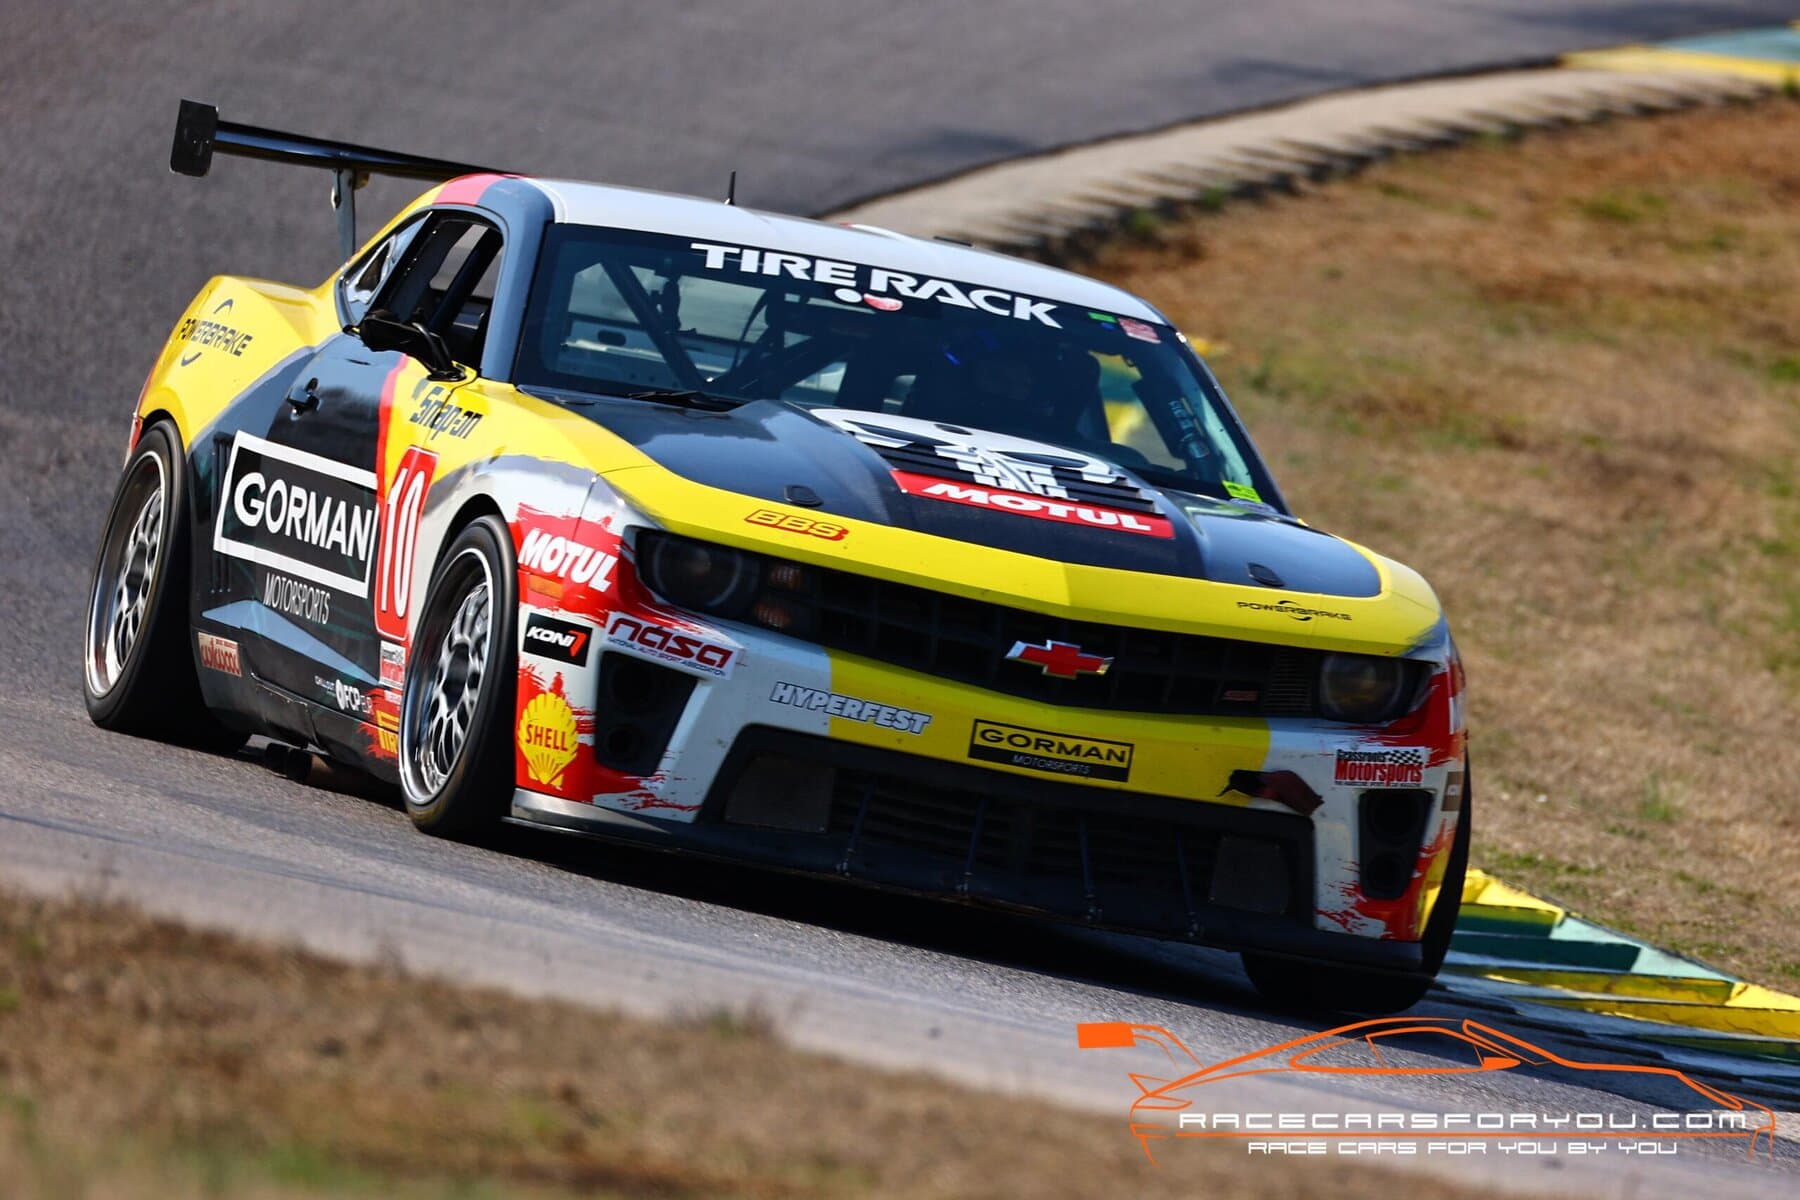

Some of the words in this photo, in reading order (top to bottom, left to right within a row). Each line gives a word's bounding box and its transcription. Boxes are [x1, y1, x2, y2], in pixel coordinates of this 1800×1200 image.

[691, 242, 857, 286] TIRE
[870, 269, 1063, 328] RACK
[410, 386, 483, 440] Snap-on
[234, 472, 372, 561] GORMAN
[745, 509, 849, 541] BBS
[924, 483, 1152, 532] MOTUL
[381, 468, 425, 618] 10
[518, 527, 618, 592] MOTUL
[263, 572, 331, 625] MOTORSPORTS
[1236, 601, 1353, 621] POWERBRAKE
[770, 681, 932, 734] HYPERFEST
[526, 724, 568, 752] SHELL
[979, 729, 1126, 763] GORMAN
[1012, 754, 1090, 775] MOTORSPORTS
[1335, 759, 1423, 787] Motorsports
